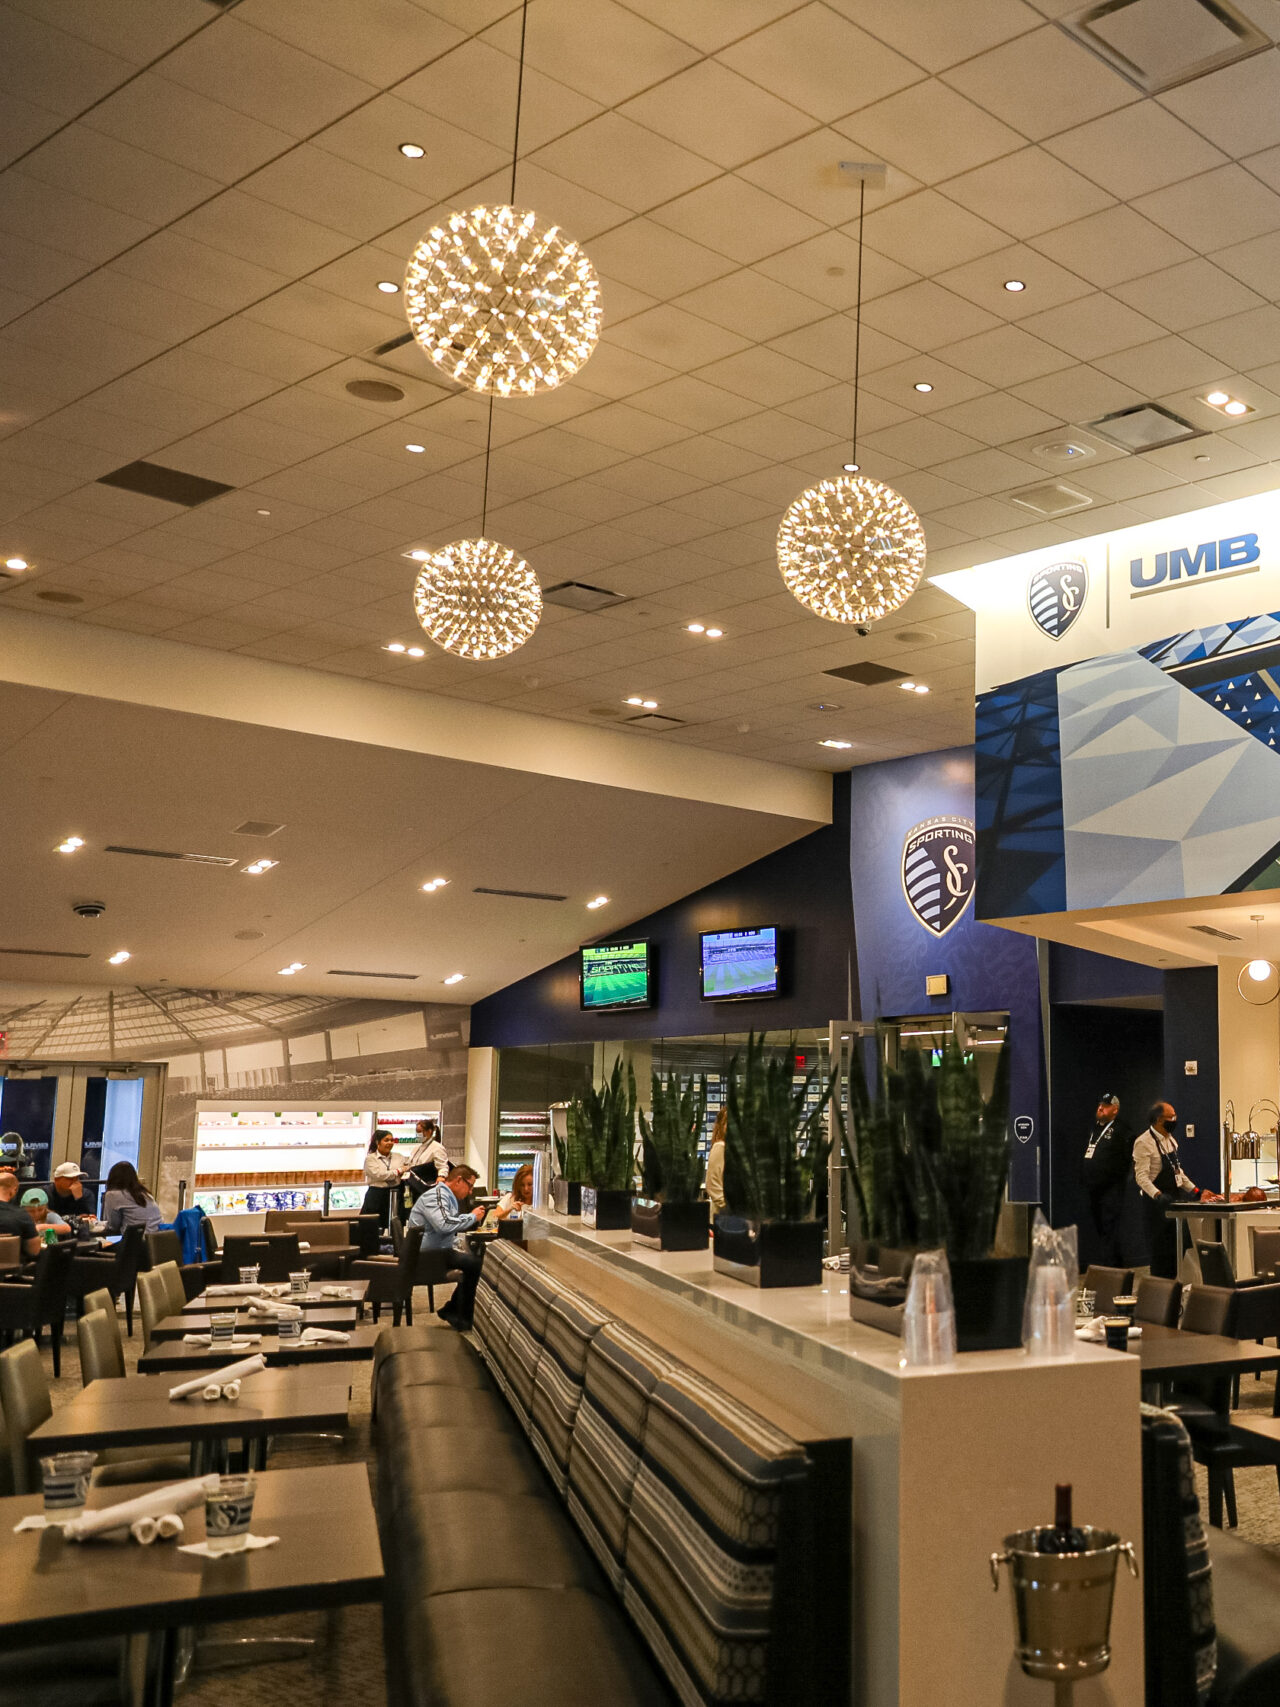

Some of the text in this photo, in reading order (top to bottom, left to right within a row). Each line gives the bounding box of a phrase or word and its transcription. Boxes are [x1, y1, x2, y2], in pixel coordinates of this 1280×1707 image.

[1130, 533, 1260, 588] UMB
[907, 816, 973, 837] KANSAS CITY
[908, 829, 973, 854] SPORTING
